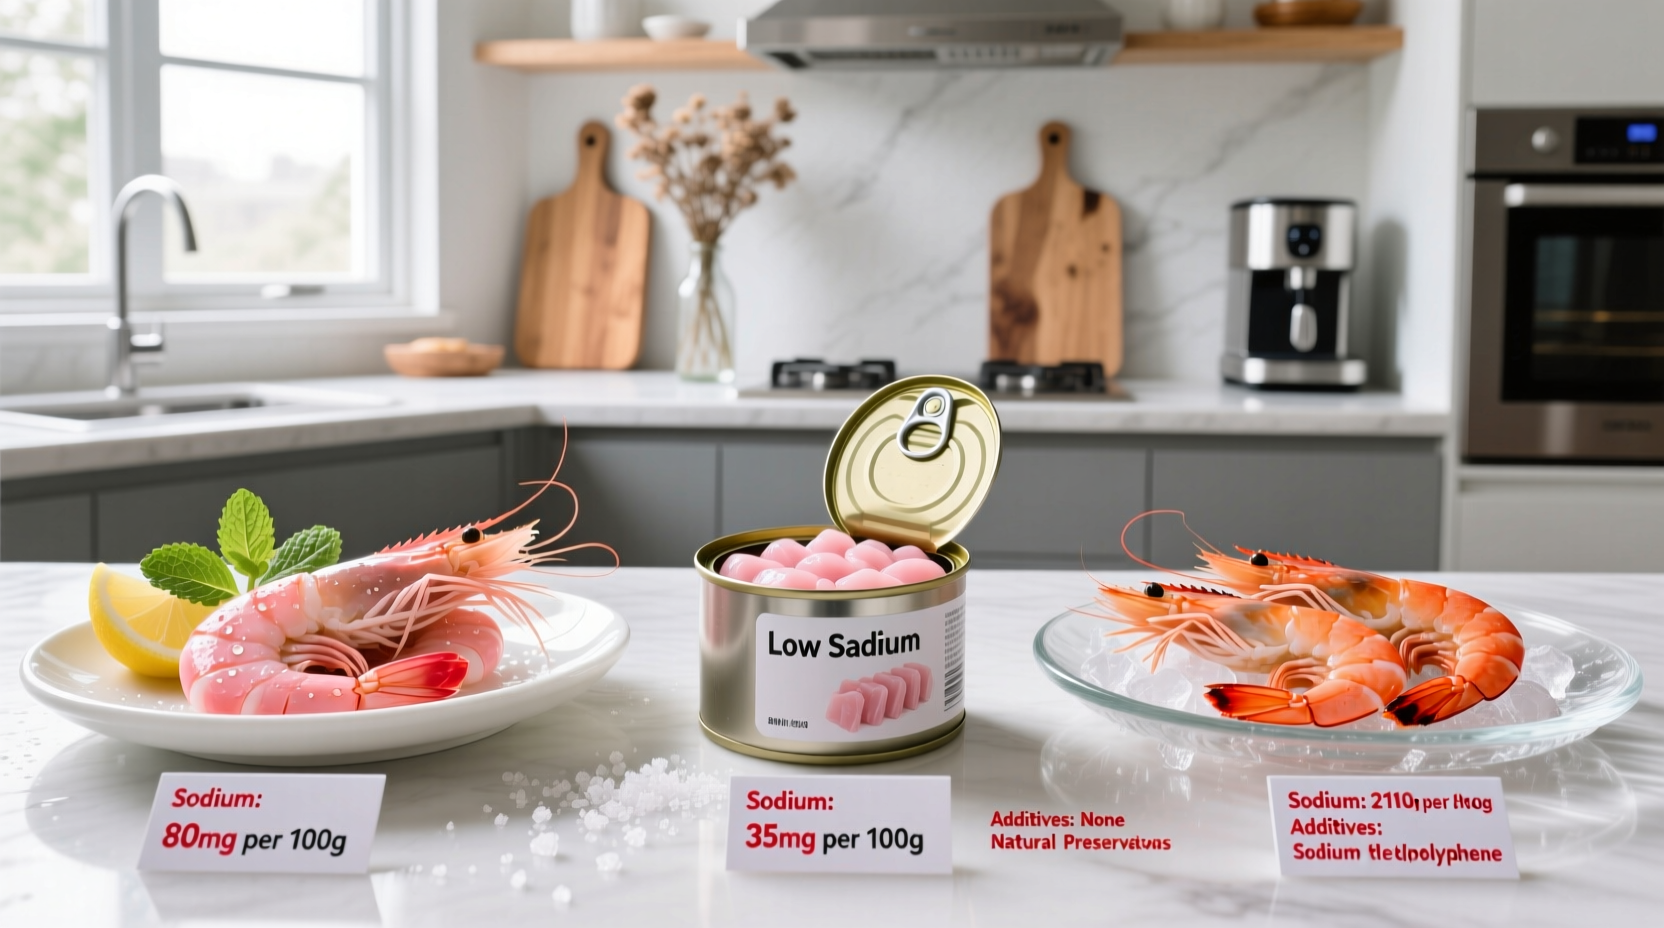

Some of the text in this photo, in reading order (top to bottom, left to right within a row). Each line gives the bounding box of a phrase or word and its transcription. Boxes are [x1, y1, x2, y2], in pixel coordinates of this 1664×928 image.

[768, 630, 821, 658] Low
[828, 630, 921, 658] Sadium
[171, 787, 263, 808] Sodium:
[745, 790, 834, 811] Sodium:
[1288, 791, 1366, 809] Sodium:
[1422, 797, 1450, 813] per
[1290, 817, 1383, 836] Additives:
[162, 822, 347, 857] 80mg per 100g
[745, 822, 924, 856] 35mg per 100g
[1293, 842, 1361, 860] Sodium
